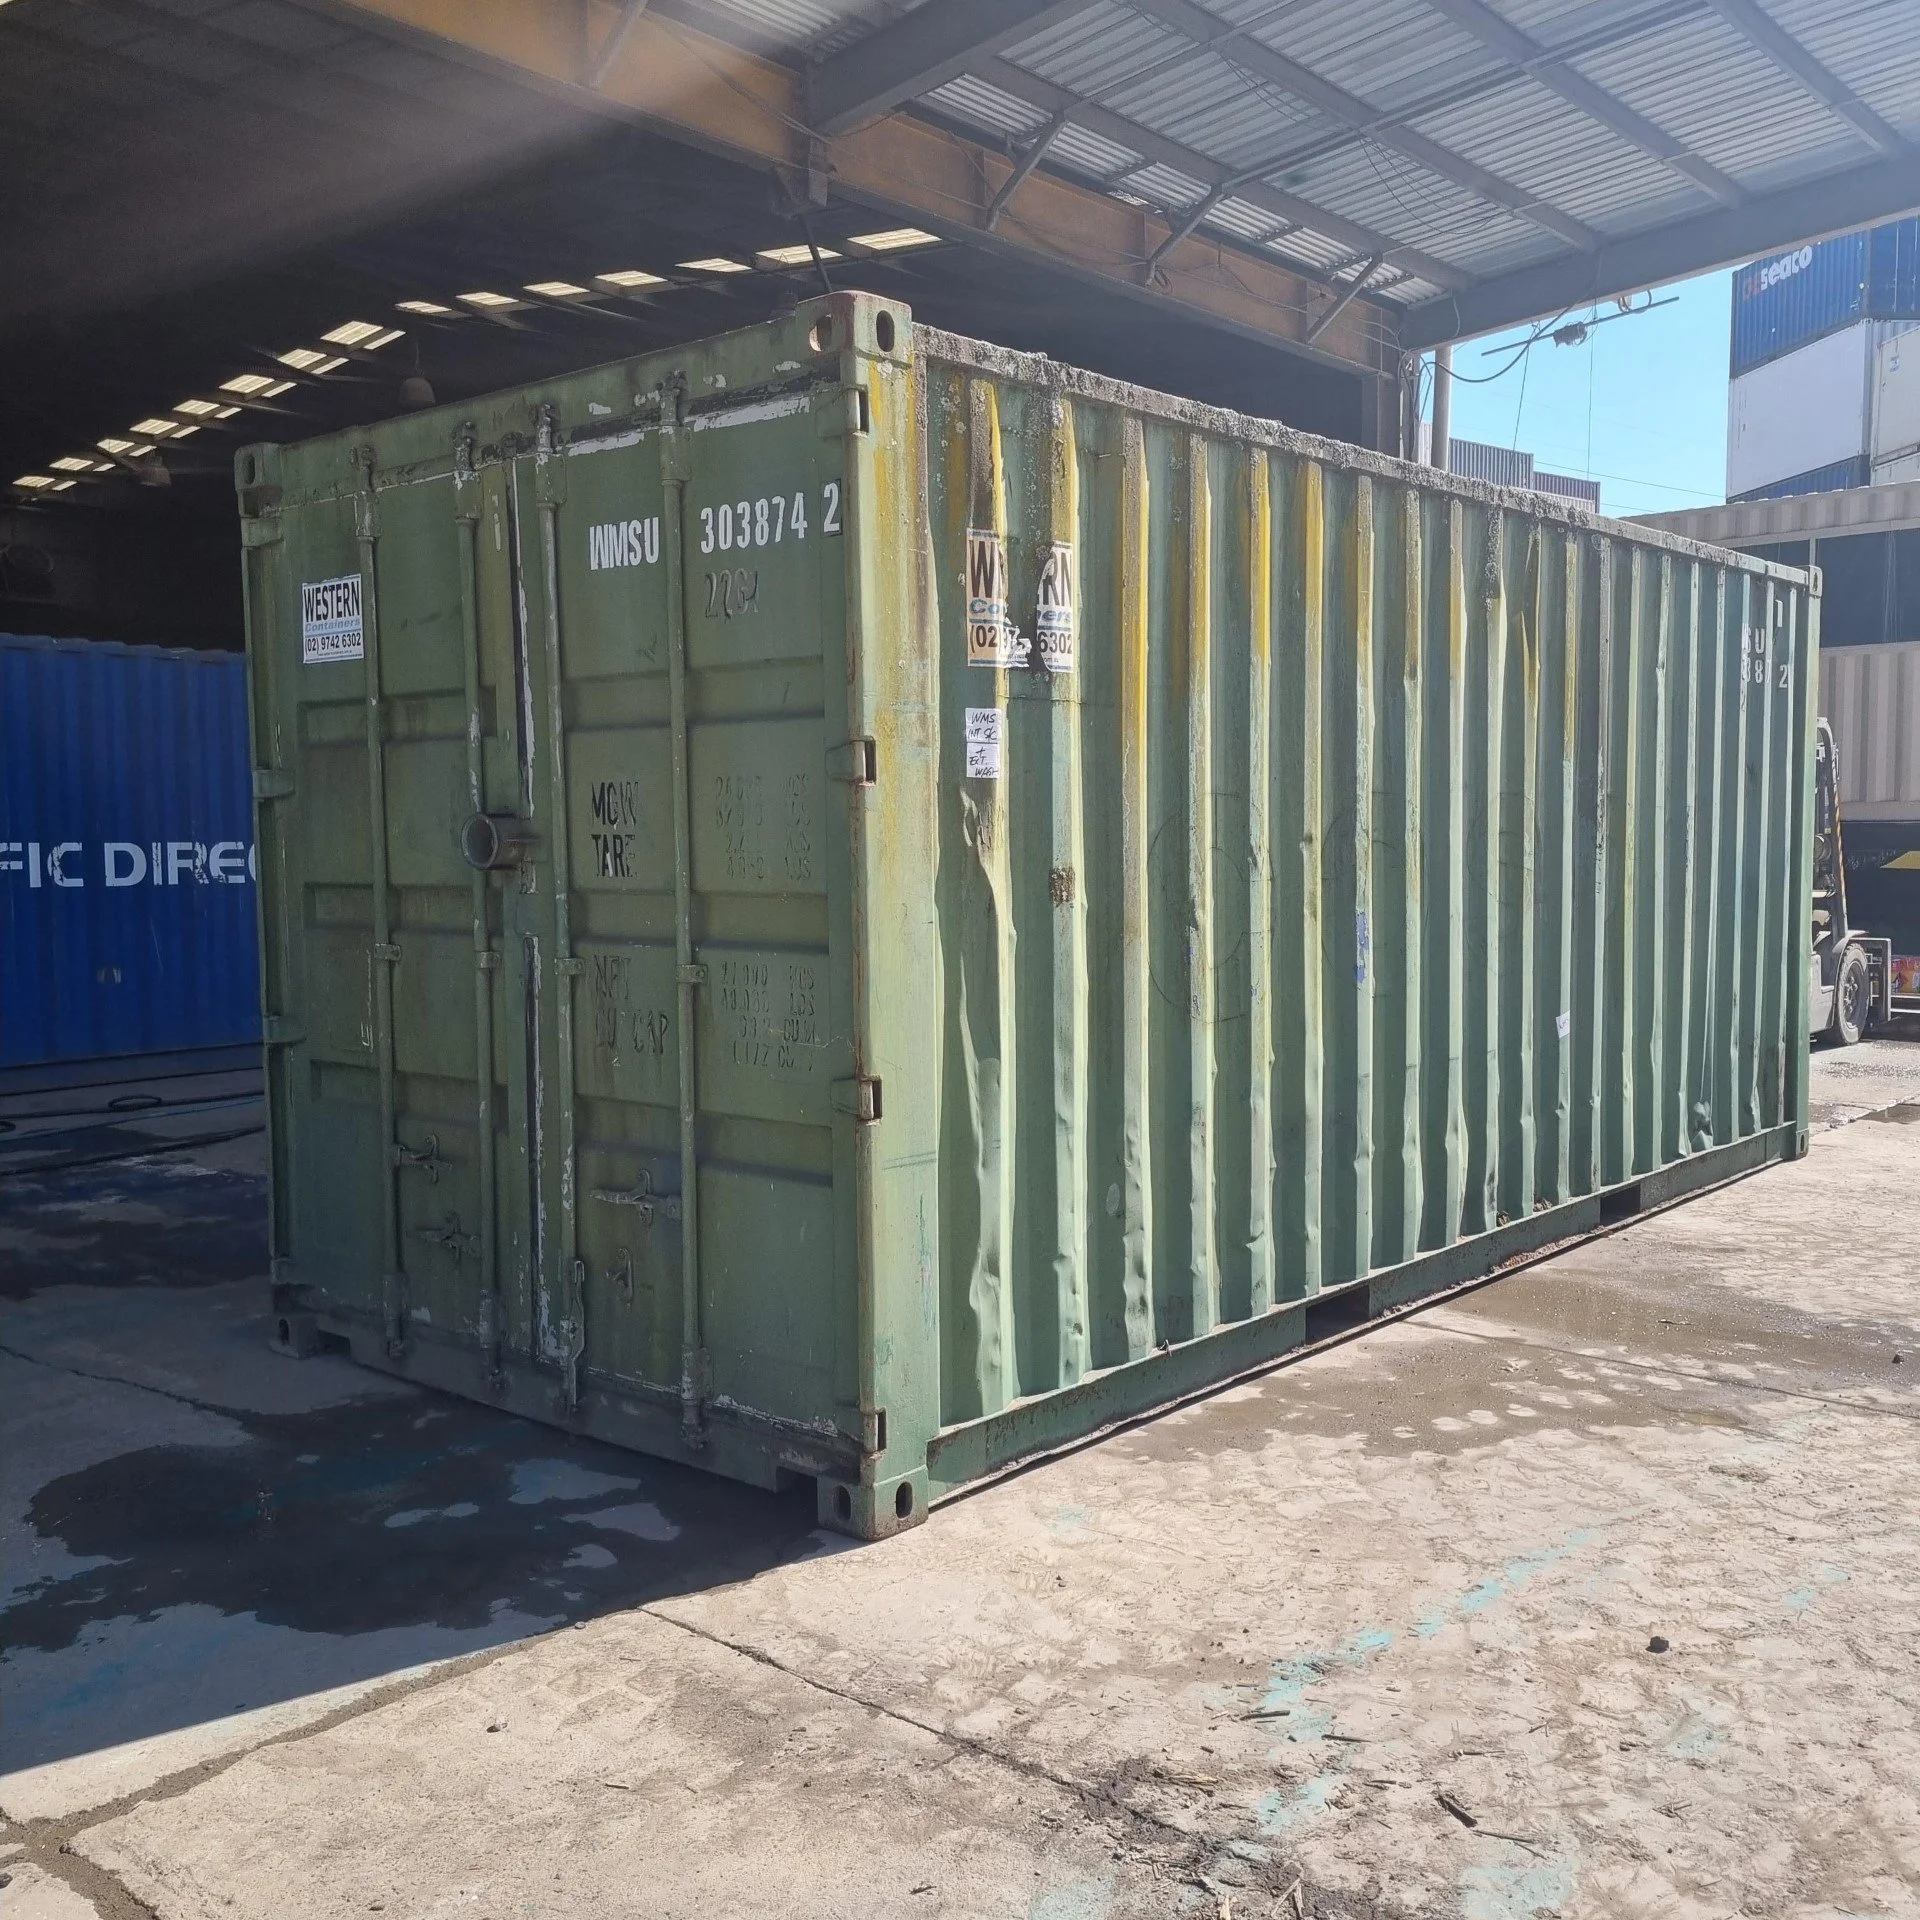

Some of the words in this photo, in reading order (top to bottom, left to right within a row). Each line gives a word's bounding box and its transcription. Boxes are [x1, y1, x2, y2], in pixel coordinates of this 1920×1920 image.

[589, 516, 660, 570] WMSU
[700, 491, 808, 554] 303874
[823, 482, 841, 533] 2
[303, 580, 361, 622] WESTERN
[305, 618, 361, 632] Containers
[305, 637, 320, 655] (02)
[321, 634, 340, 651] 9742
[342, 632, 361, 649] 6302
[1037, 631, 1073, 655] 6302
[971, 711, 996, 725] WMS
[104, 841, 256, 887] DIRE
[591, 832, 637, 878] TARE
